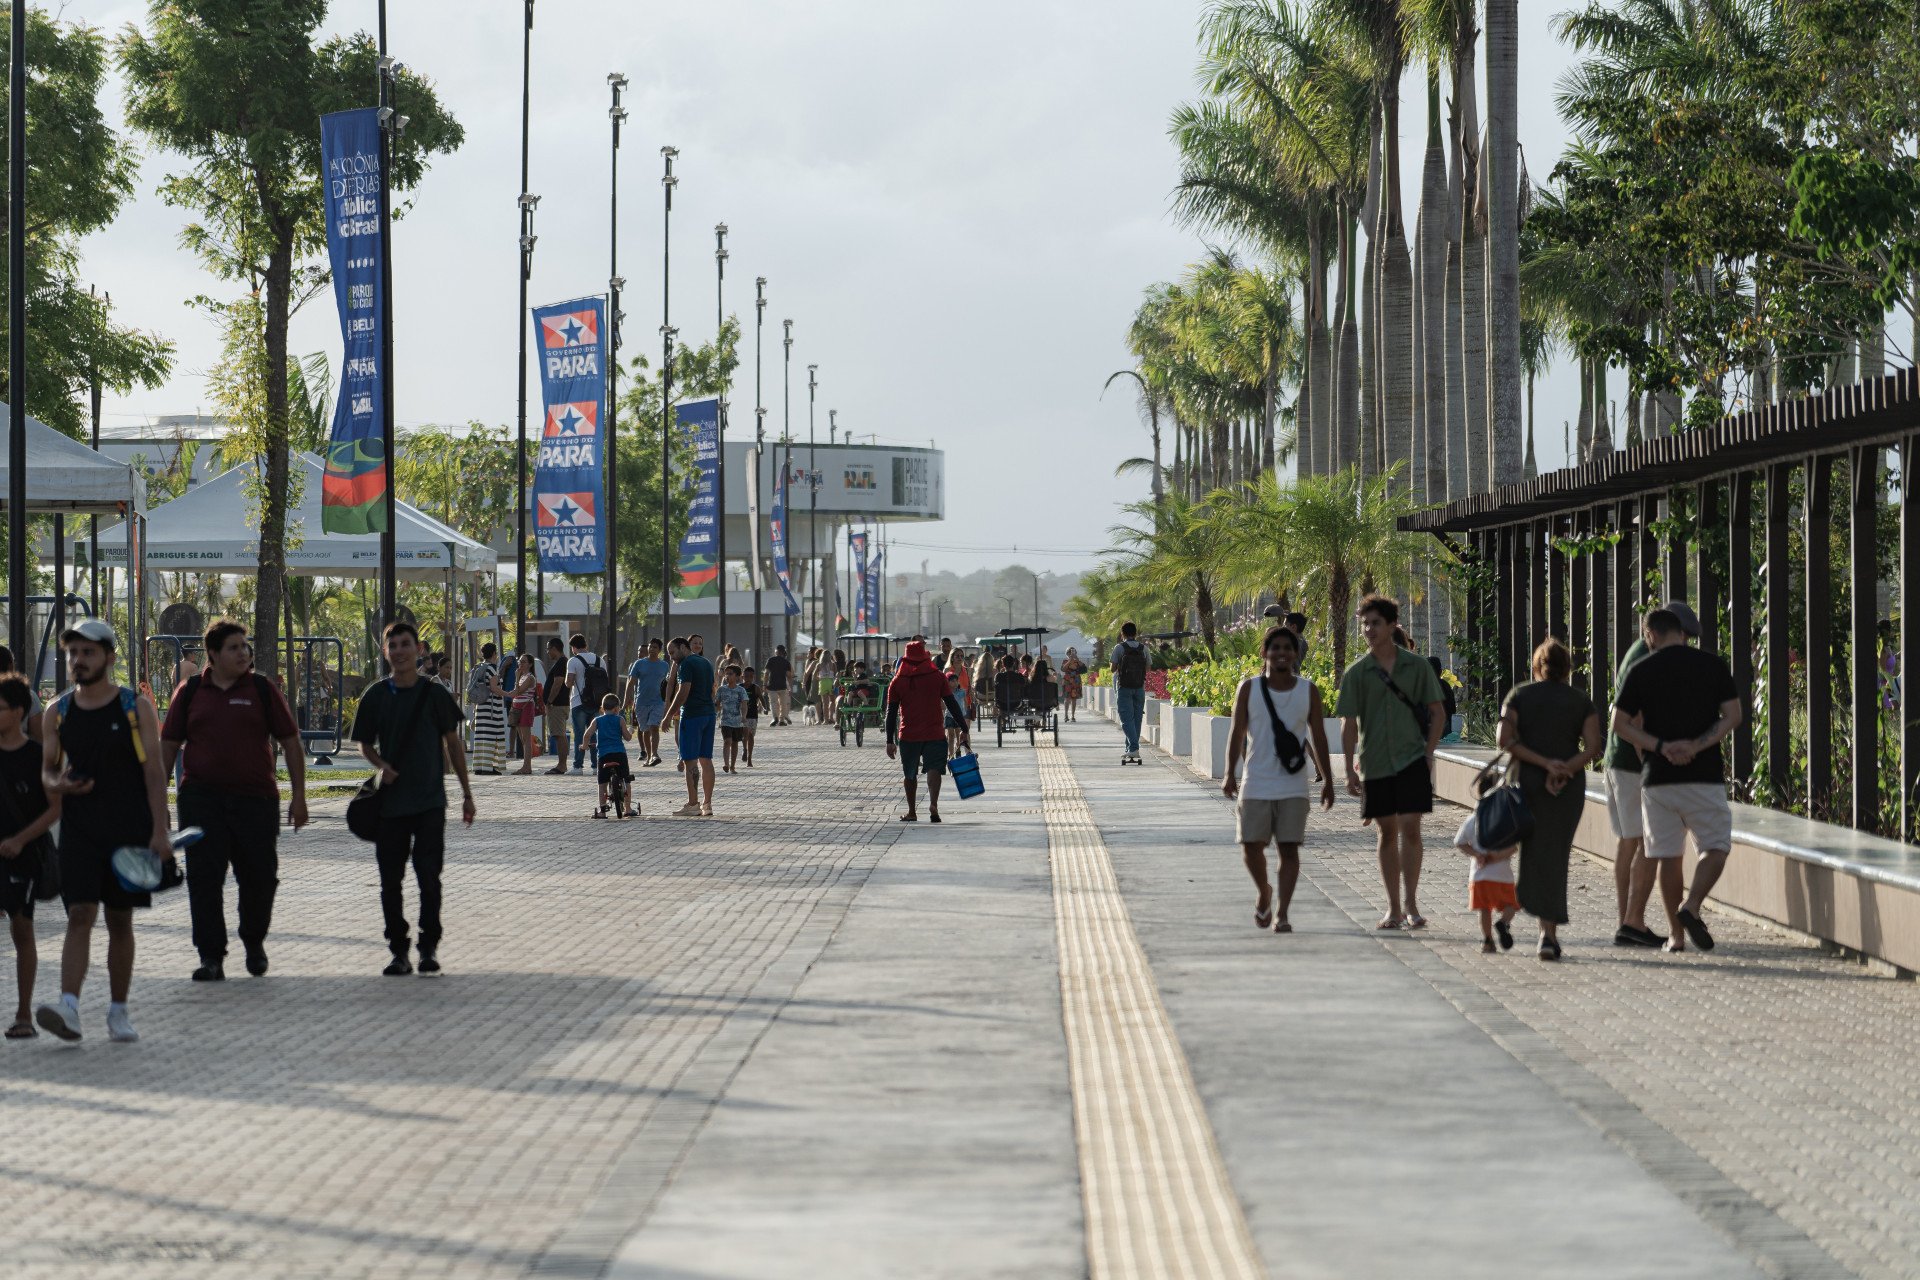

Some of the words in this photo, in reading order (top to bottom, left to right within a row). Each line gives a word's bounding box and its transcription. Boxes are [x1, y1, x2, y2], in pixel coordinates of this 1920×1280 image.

[545, 348, 583, 357] GOVERNO
[542, 438, 580, 446] GOVERNO
[537, 528, 578, 536] GOVERNO
